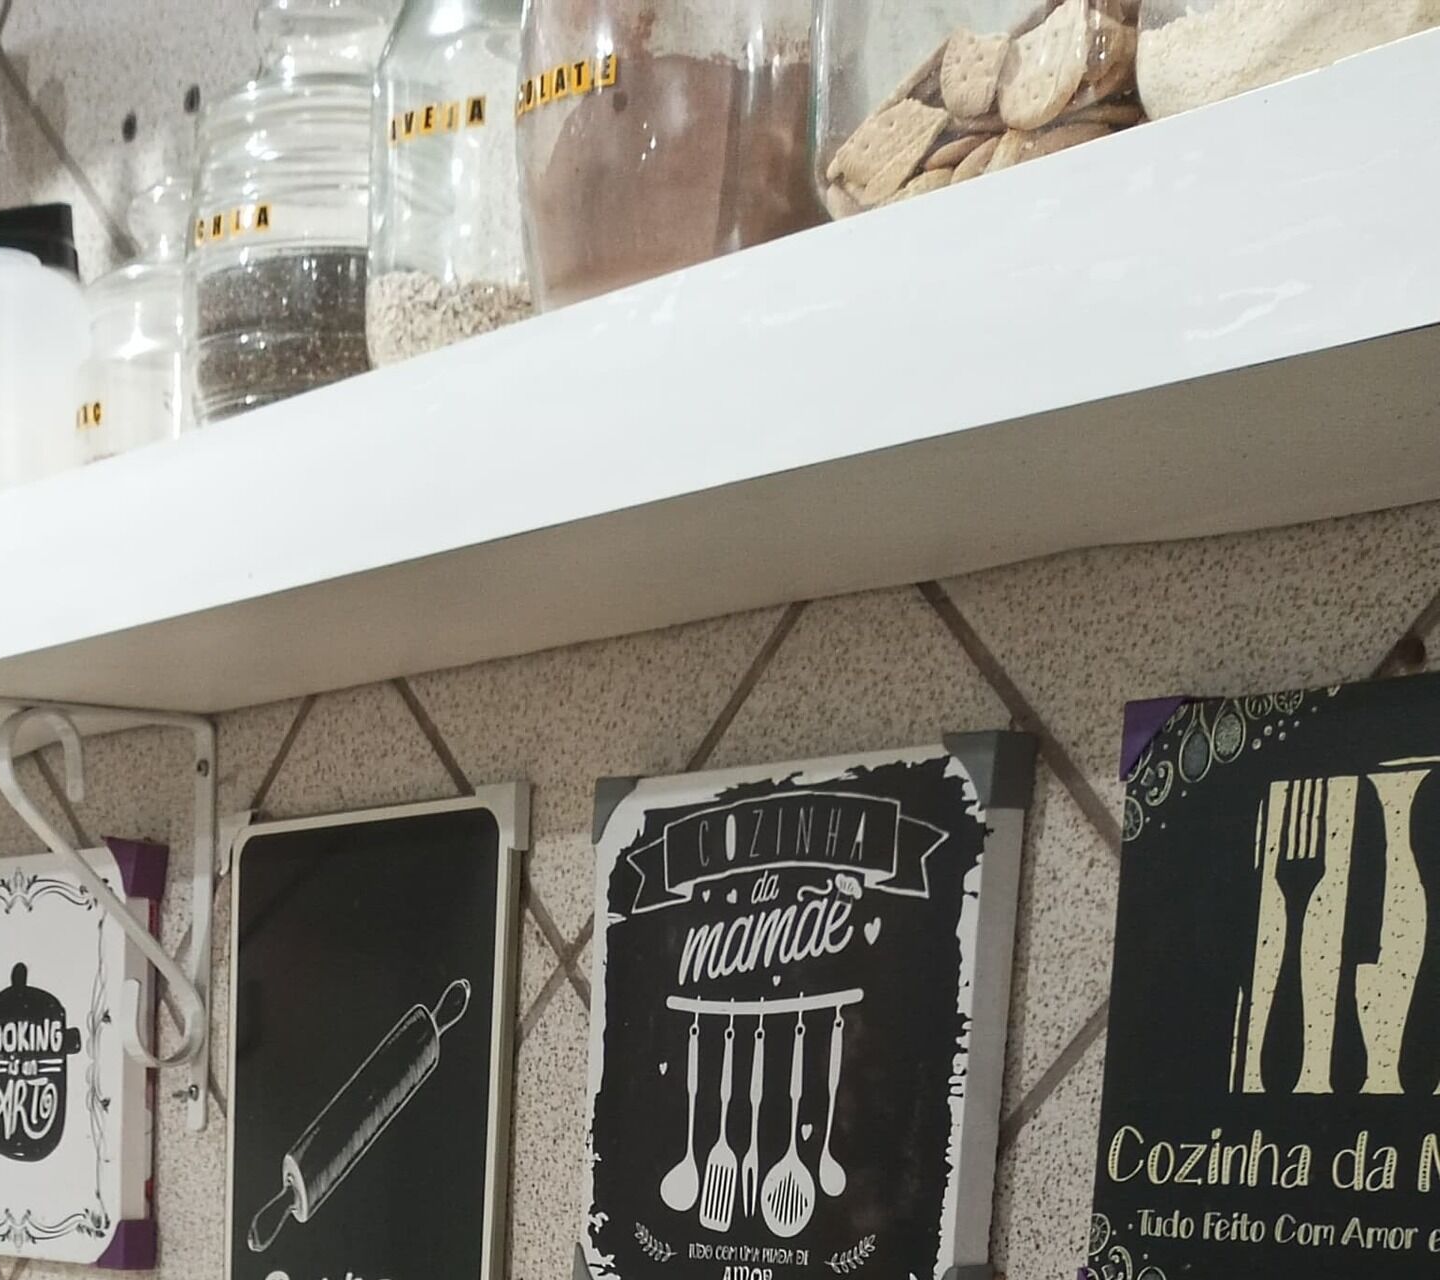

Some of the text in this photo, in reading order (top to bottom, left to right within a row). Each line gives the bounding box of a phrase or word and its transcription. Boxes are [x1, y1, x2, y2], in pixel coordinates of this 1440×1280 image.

[698, 805, 867, 867] COZINHA
[751, 870, 779, 904] da
[678, 878, 855, 986] mamãe
[1108, 1126, 1311, 1189] Cozinha
[1332, 1130, 1397, 1192] da
[715, 1245, 739, 1261] COM
[1137, 1209, 1194, 1239] Tudo
[1202, 1211, 1265, 1242] Feito
[1274, 1213, 1335, 1246] Com
[1340, 1217, 1419, 1250] Amor
